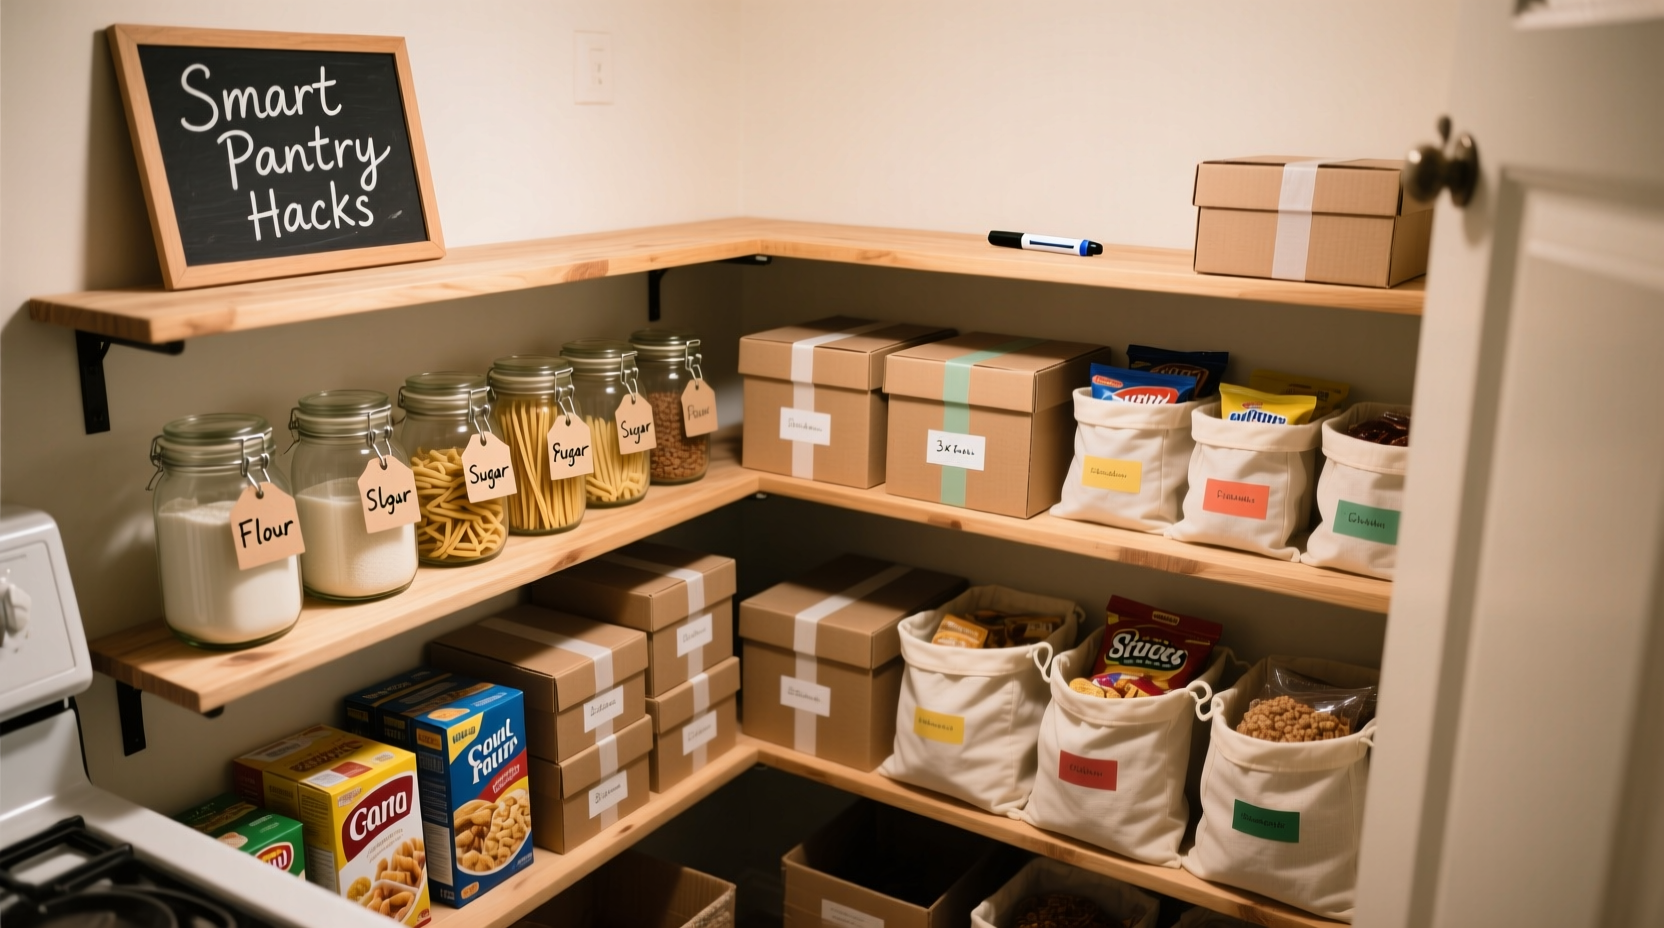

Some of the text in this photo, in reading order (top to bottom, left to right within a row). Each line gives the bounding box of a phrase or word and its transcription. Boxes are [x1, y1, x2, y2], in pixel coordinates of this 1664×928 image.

[180, 62, 342, 133] Smart
[216, 125, 391, 192] Pantry
[246, 180, 375, 241] Hacks
[469, 464, 510, 489] Sugar
[238, 517, 294, 549] Flour
